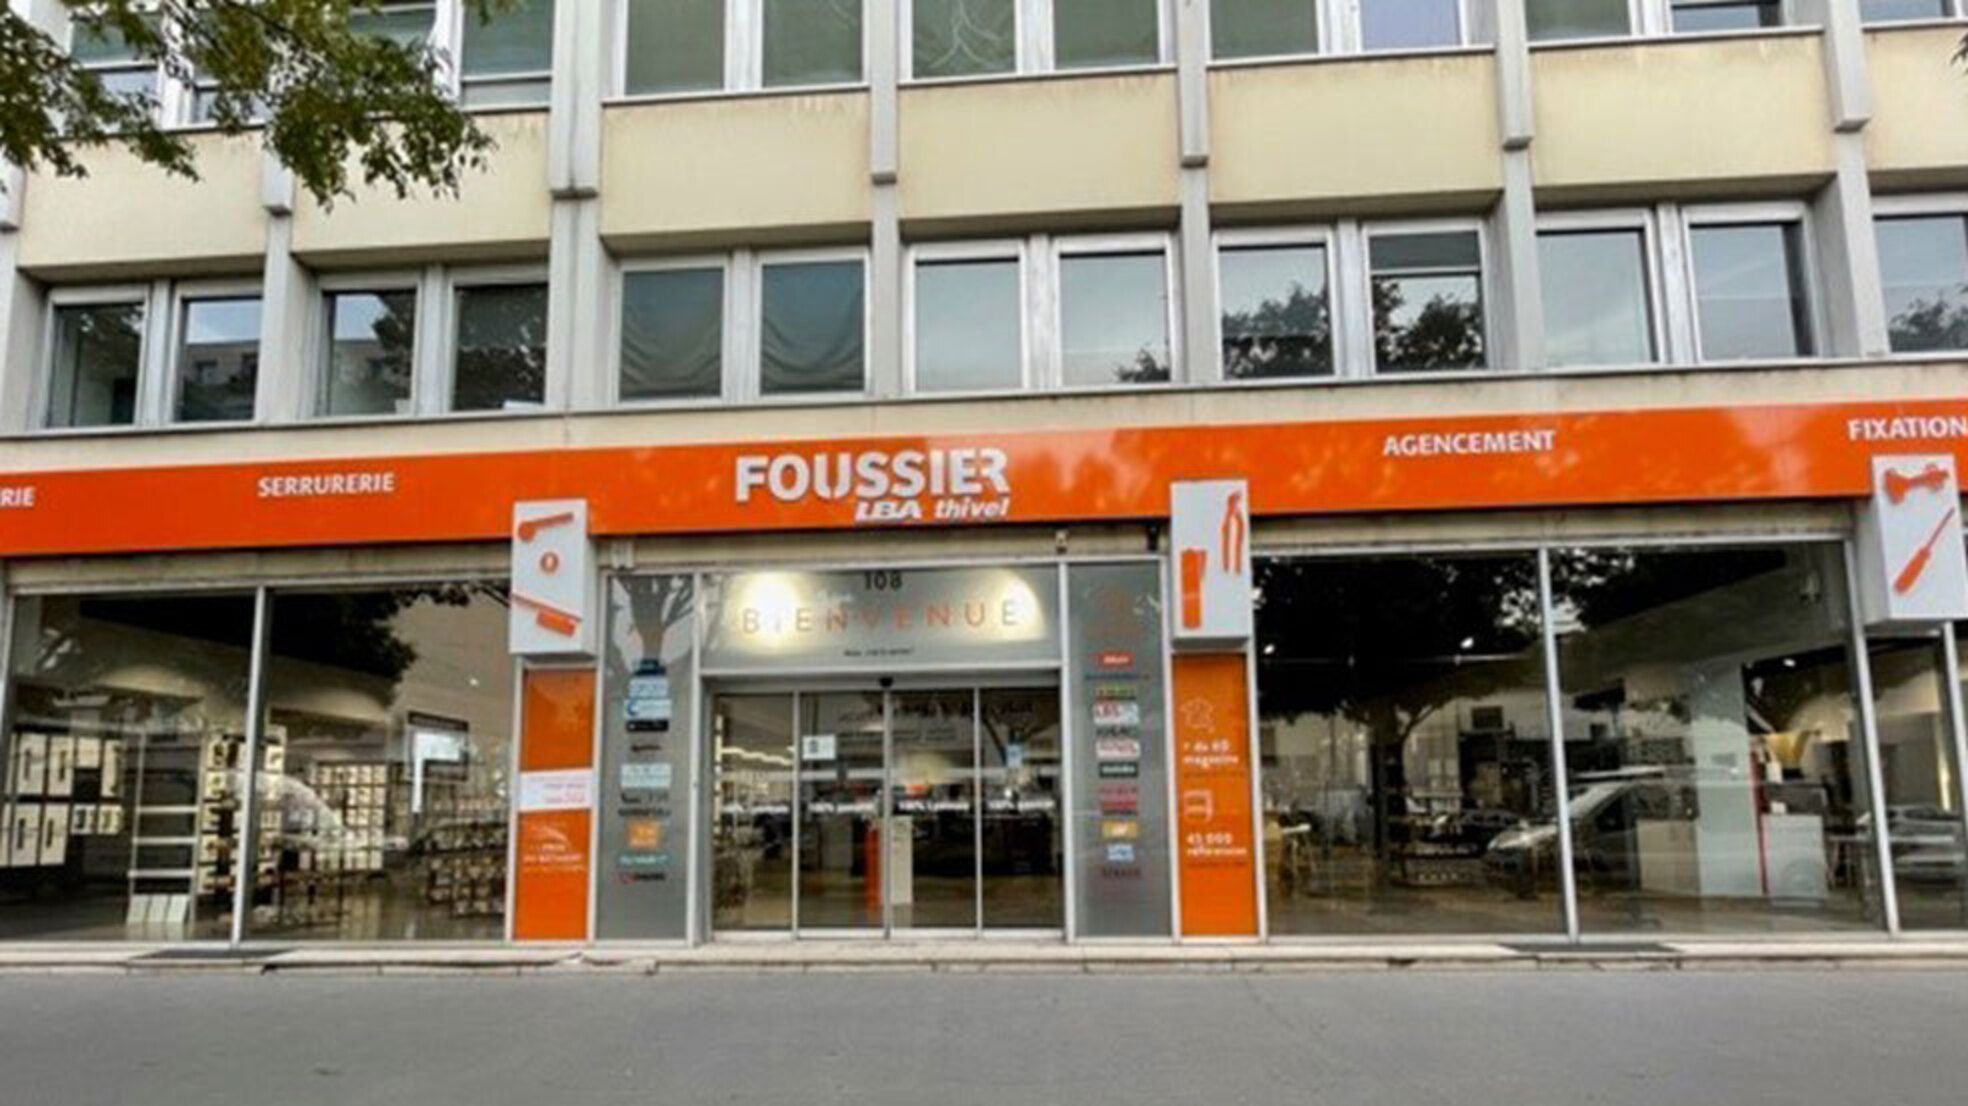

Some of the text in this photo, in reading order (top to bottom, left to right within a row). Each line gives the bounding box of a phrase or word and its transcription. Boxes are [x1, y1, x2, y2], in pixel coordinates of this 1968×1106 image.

[1848, 415, 1968, 440] FIXATION
[1383, 429, 1556, 456] AGENCEMENT
[257, 472, 395, 498] SERRURERIE
[734, 447, 1011, 503] FOUSSIER
[855, 496, 1011, 522] LBA thivel
[863, 571, 903, 592] 108
[742, 600, 1018, 635] BIENVENUE
